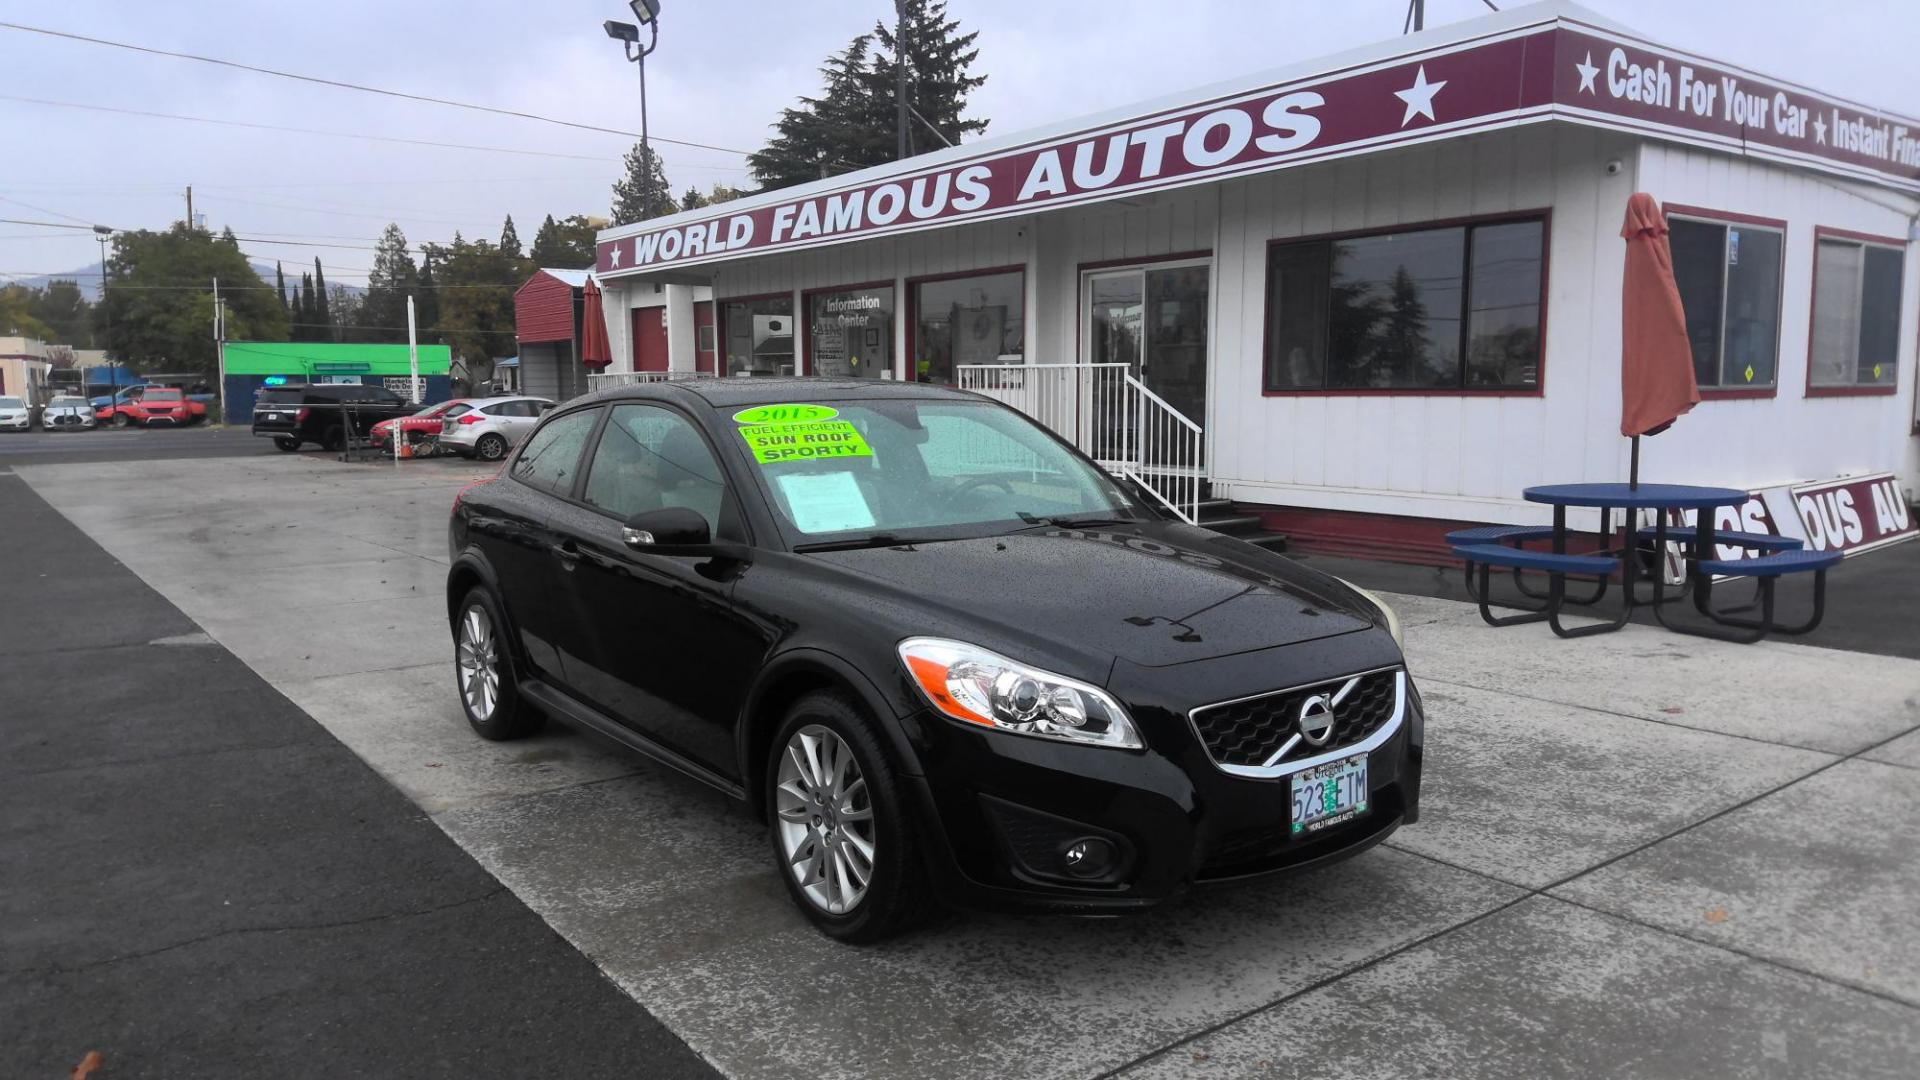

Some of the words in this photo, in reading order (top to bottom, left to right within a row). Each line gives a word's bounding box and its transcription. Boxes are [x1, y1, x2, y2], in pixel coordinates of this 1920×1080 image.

[1608, 47, 1672, 109] Cash
[1678, 66, 1717, 117] For
[1721, 76, 1769, 130] Your
[1773, 91, 1808, 139] Car
[1831, 108, 1890, 160] Instant
[634, 215, 755, 265] WORLD
[770, 166, 993, 243] FAMOUS
[1016, 91, 1326, 202] AUTOS
[826, 295, 880, 312] Information
[837, 315, 869, 327] Center
[756, 407, 819, 422] 2015
[743, 426, 779, 436] FUEL
[783, 422, 848, 433] EFFICIENT
[757, 435, 797, 447] SUN
[803, 432, 853, 443] ROOF
[763, 445, 858, 461] SPORTY
[1871, 479, 1909, 535] AU
[1292, 782, 1326, 823] 523
[1335, 769, 1366, 809] ETM
[1342, 811, 1354, 822] AUTO
